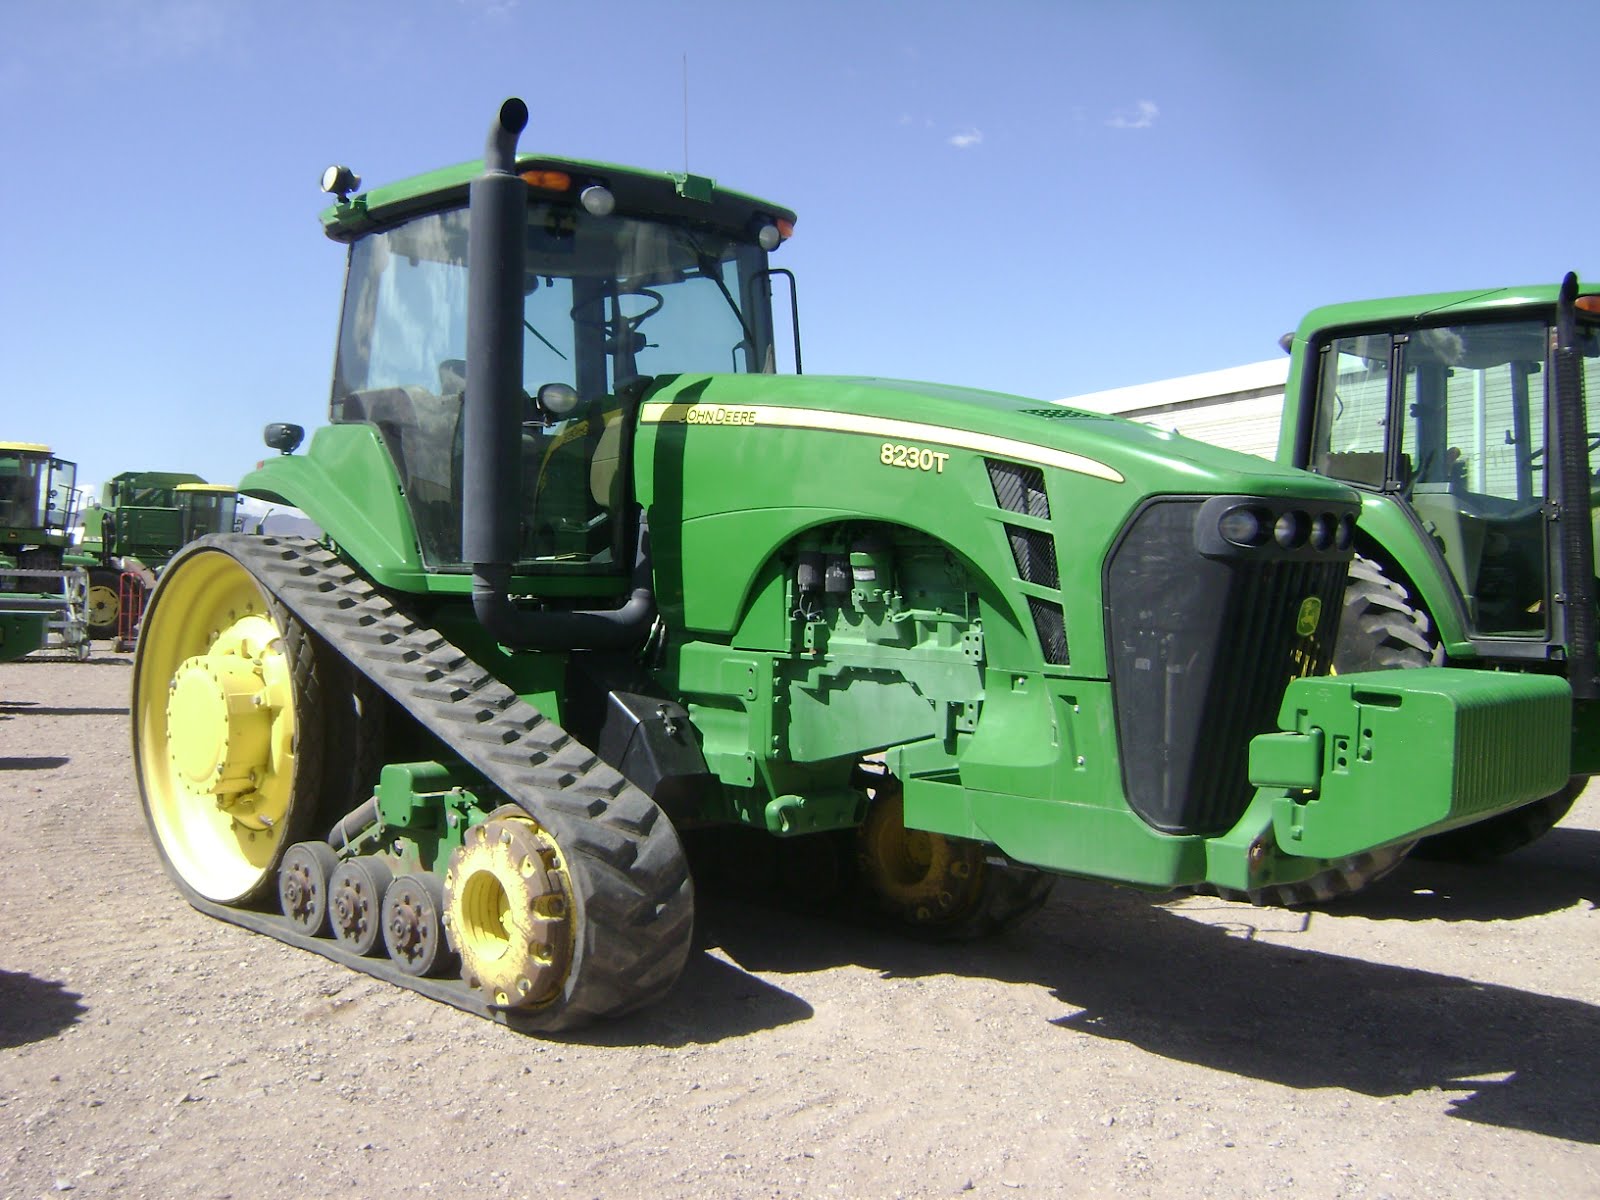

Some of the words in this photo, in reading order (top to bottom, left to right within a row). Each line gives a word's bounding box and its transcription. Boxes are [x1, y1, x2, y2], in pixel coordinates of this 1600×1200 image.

[681, 407, 714, 422] JOHN
[715, 408, 757, 423] DEERE
[880, 442, 950, 474] 8230T
